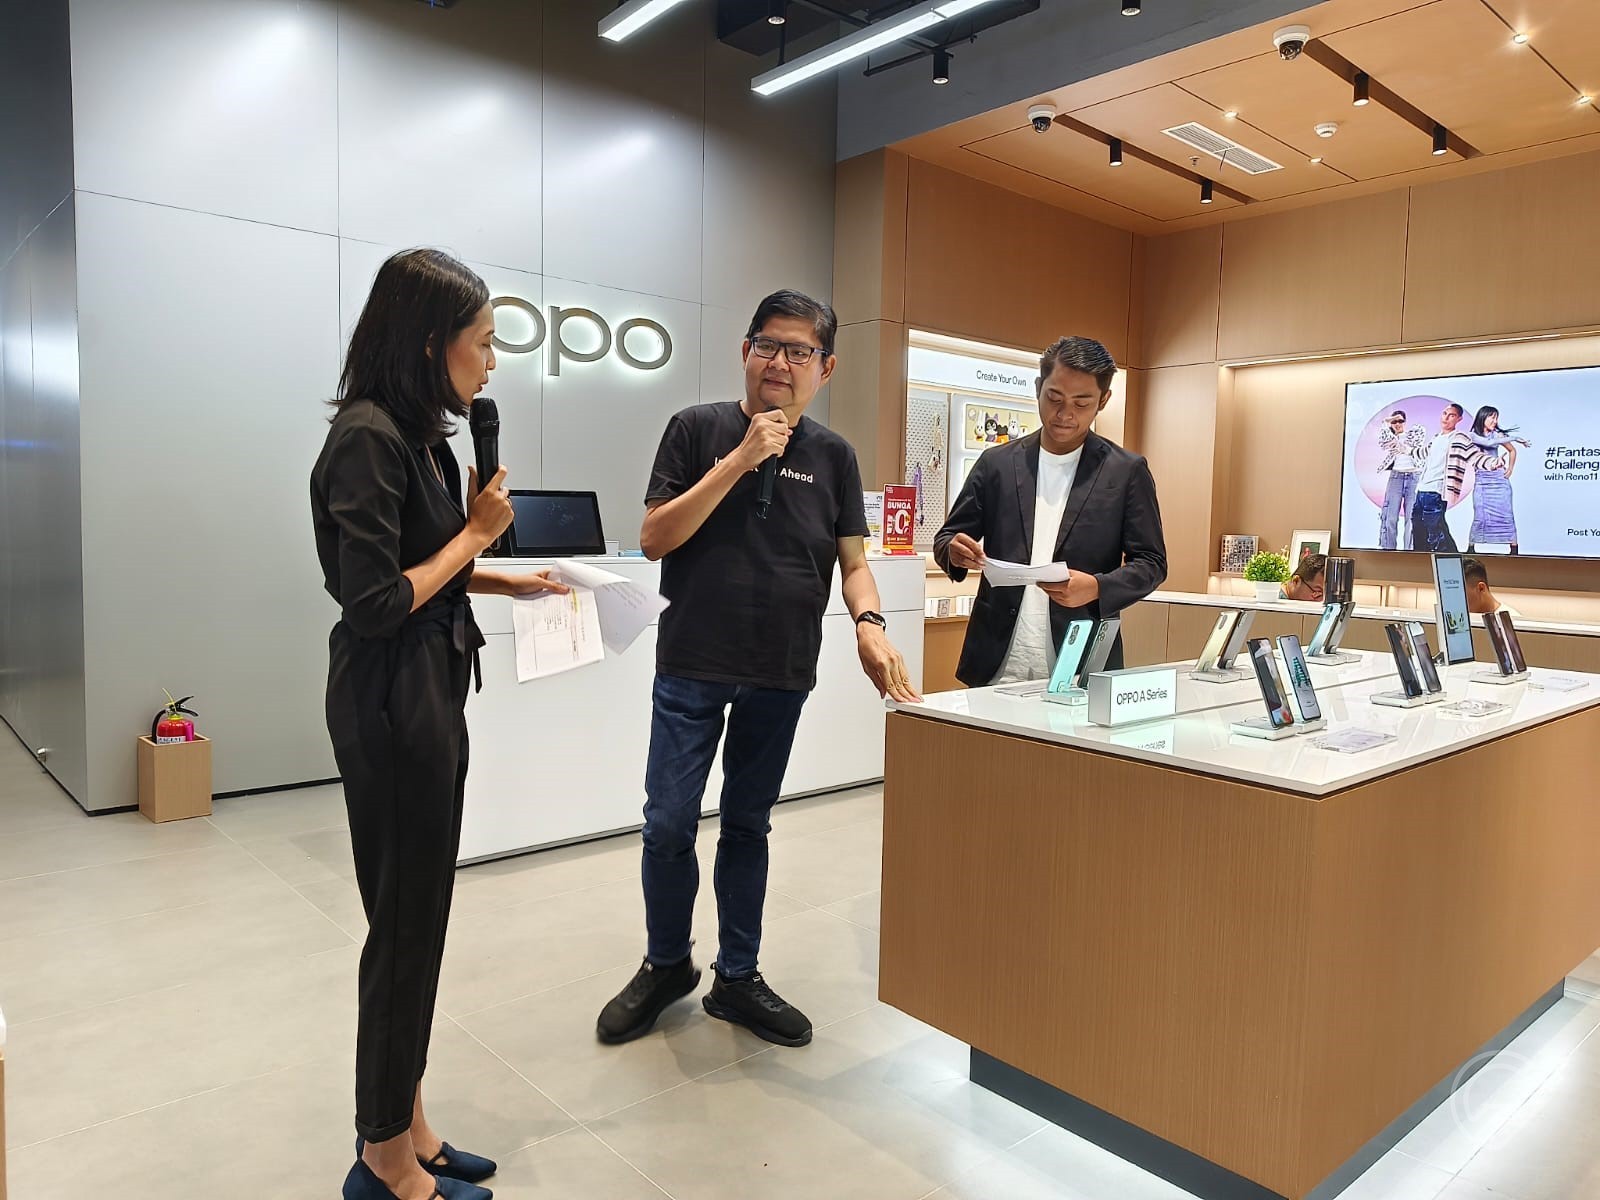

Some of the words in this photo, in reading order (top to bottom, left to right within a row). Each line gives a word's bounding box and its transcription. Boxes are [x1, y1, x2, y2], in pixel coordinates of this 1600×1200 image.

[976, 370, 998, 381] Create
[998, 373, 1011, 383] Your
[1012, 375, 1027, 387] Own
[1544, 459, 1600, 471] Challeng
[780, 467, 813, 483] Ahead
[1544, 472, 1564, 481] with
[1565, 472, 1598, 481] Reno11
[1567, 528, 1588, 536] Post
[1116, 690, 1139, 705] OPPO
[1140, 690, 1146, 702] A
[1146, 688, 1167, 700] Series
